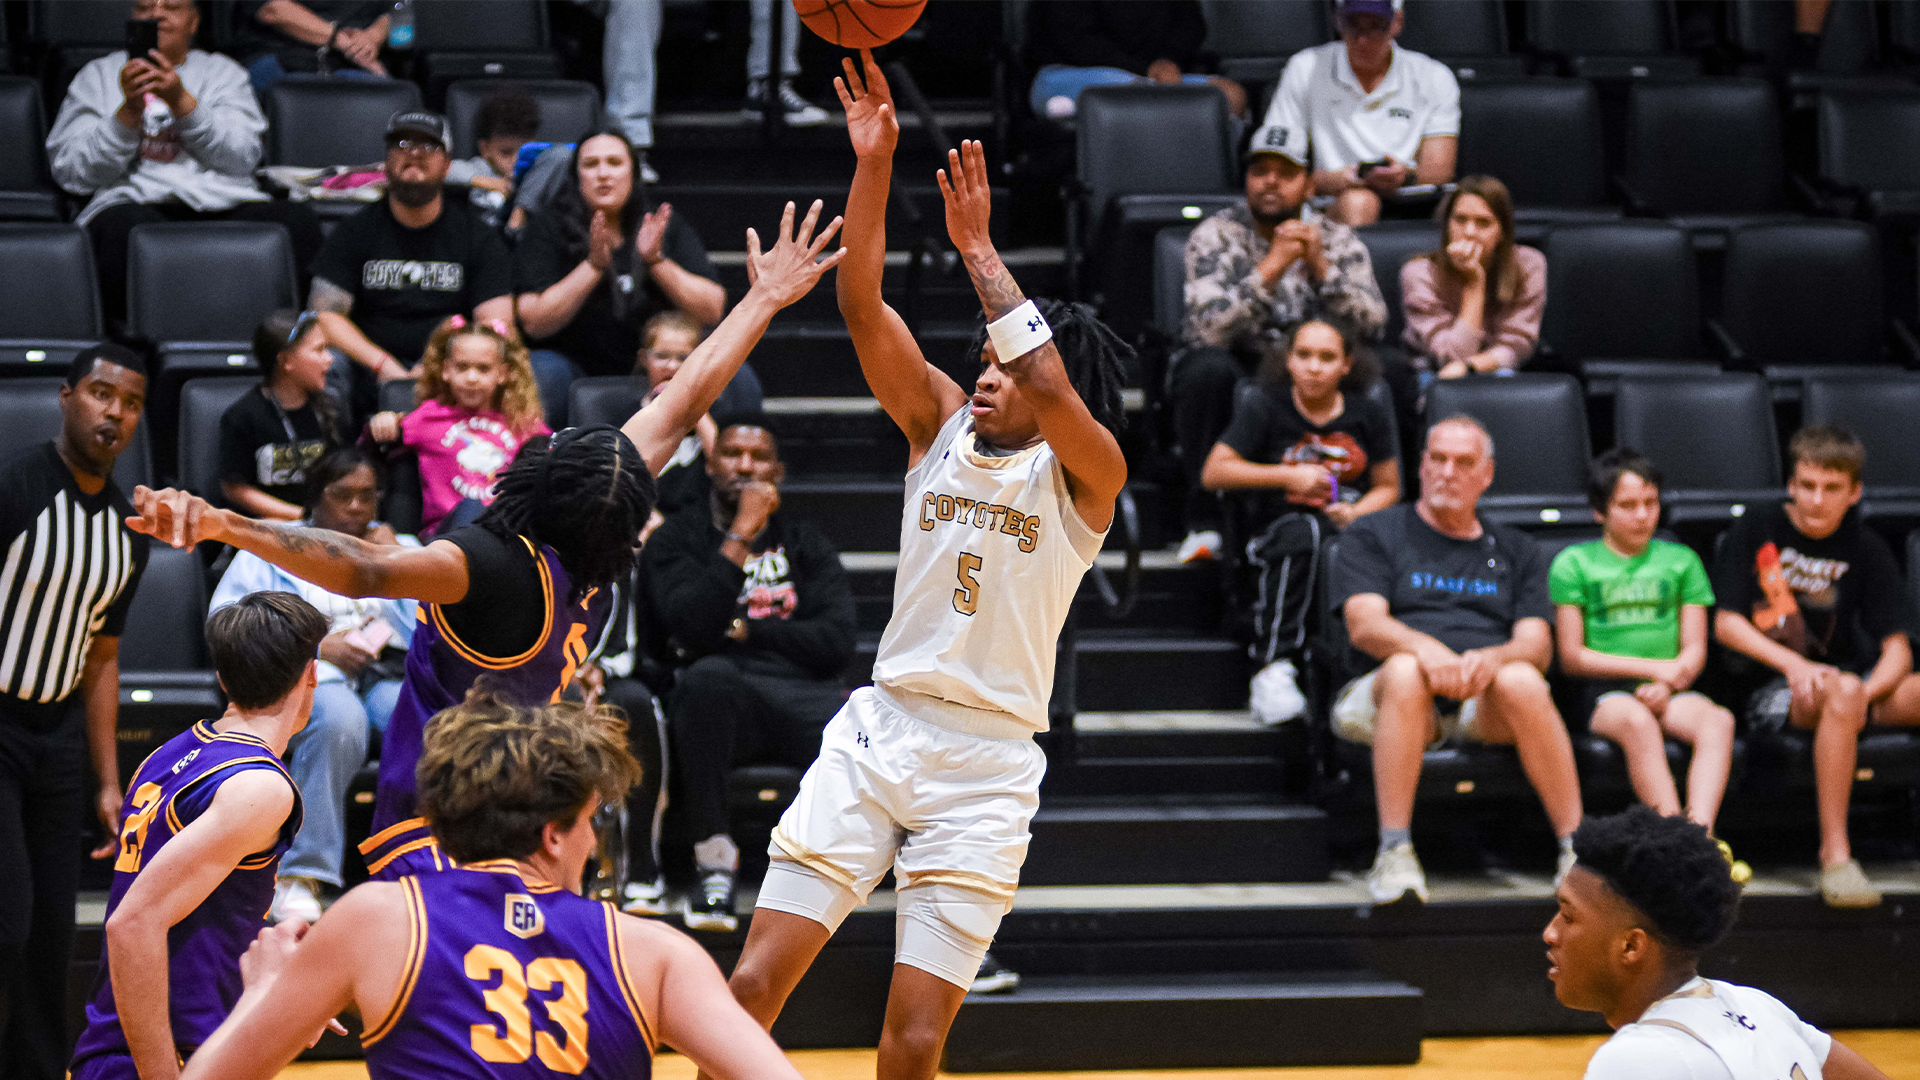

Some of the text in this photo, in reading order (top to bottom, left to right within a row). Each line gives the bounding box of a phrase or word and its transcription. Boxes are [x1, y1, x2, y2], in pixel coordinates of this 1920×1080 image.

[363, 260, 463, 291] COYTES
[919, 491, 1040, 553] COYOTES
[952, 551, 983, 616] 5
[512, 901, 537, 931] EA
[464, 944, 589, 1076] 33
